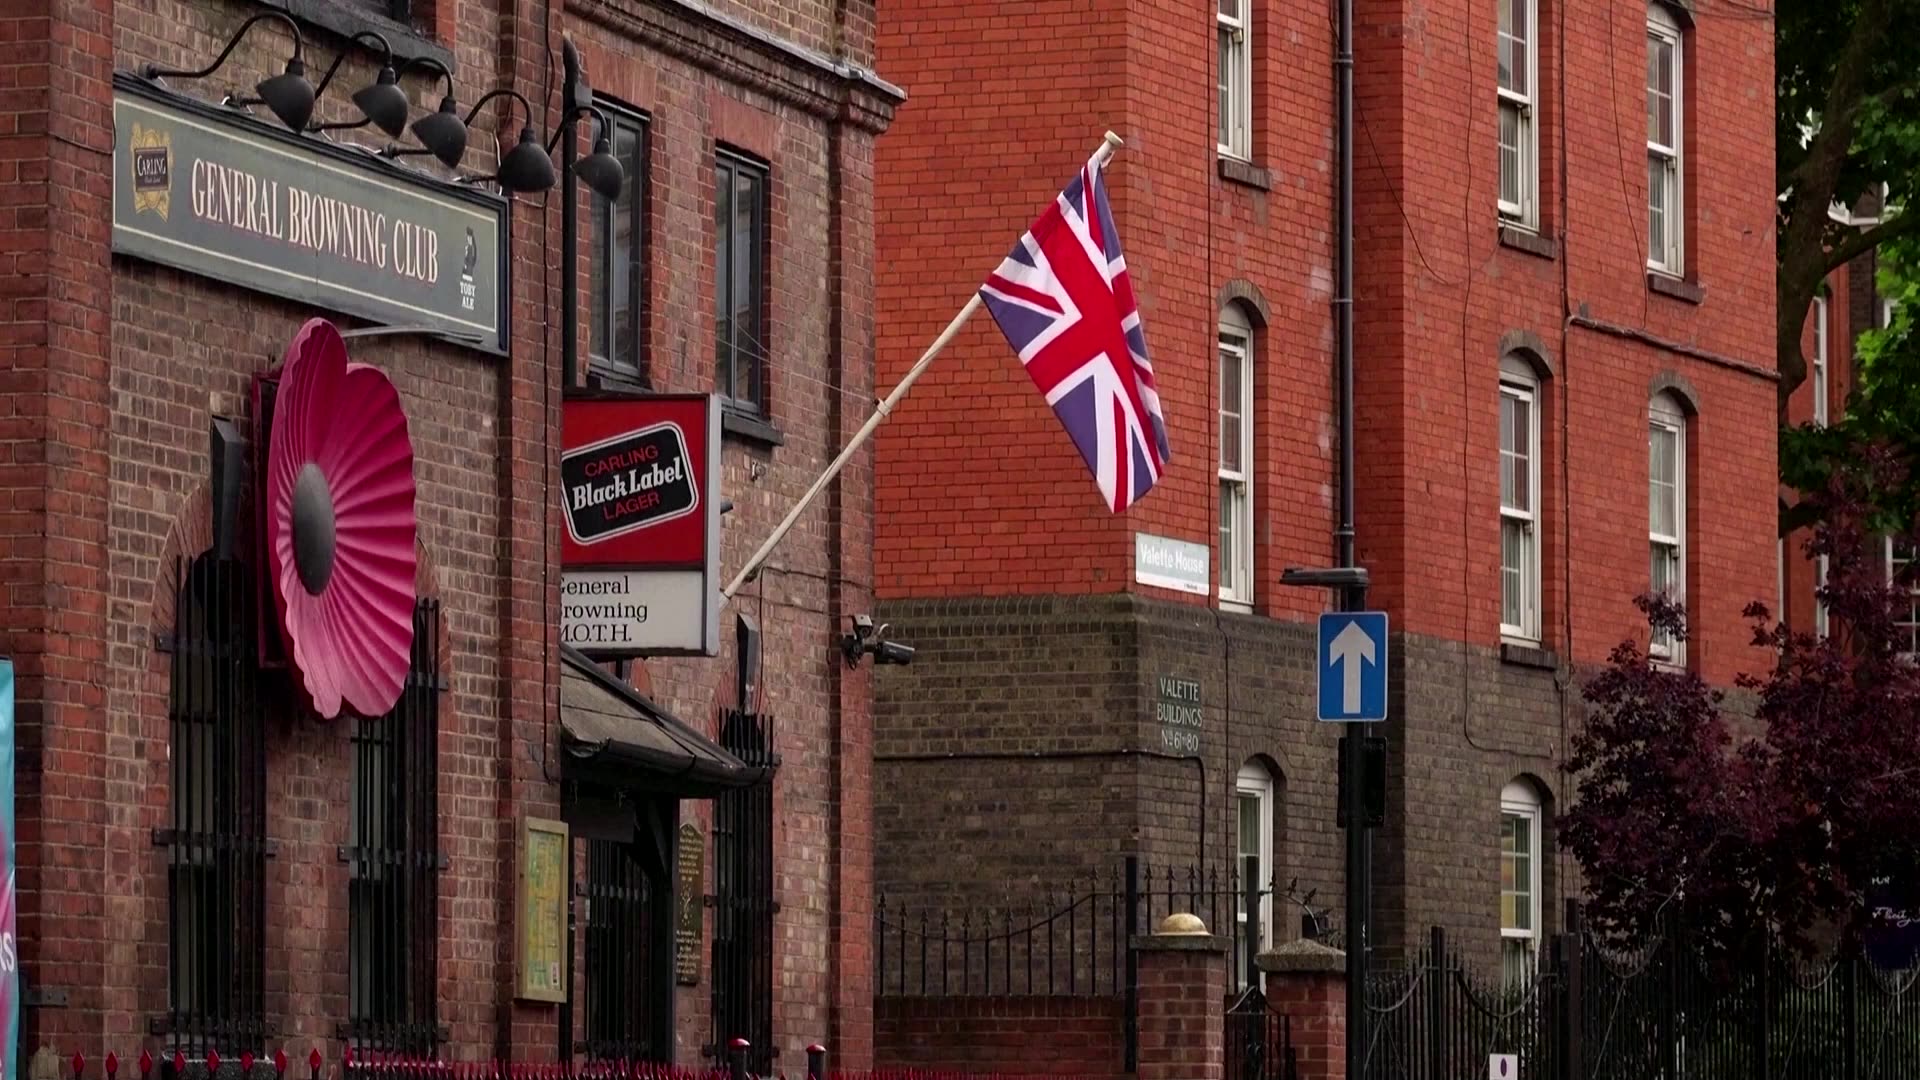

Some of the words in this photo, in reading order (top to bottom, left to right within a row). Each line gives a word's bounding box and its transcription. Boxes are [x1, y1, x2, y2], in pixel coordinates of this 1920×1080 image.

[137, 155, 166, 177] CARLING
[191, 158, 283, 239] GENERAL
[288, 185, 387, 270] BROWNING
[393, 219, 438, 285] CLUB
[460, 281, 476, 297] TOBY
[462, 296, 475, 310] ALE
[584, 444, 659, 478] CARLING
[572, 474, 628, 512] Black
[628, 456, 684, 494] Label
[602, 492, 661, 520] LAGER
[1141, 543, 1174, 569] Valette
[1175, 550, 1205, 574] House
[561, 602, 648, 623] rowning
[1160, 677, 1199, 702] VALETTE
[1157, 703, 1202, 727] BUILDINGS
